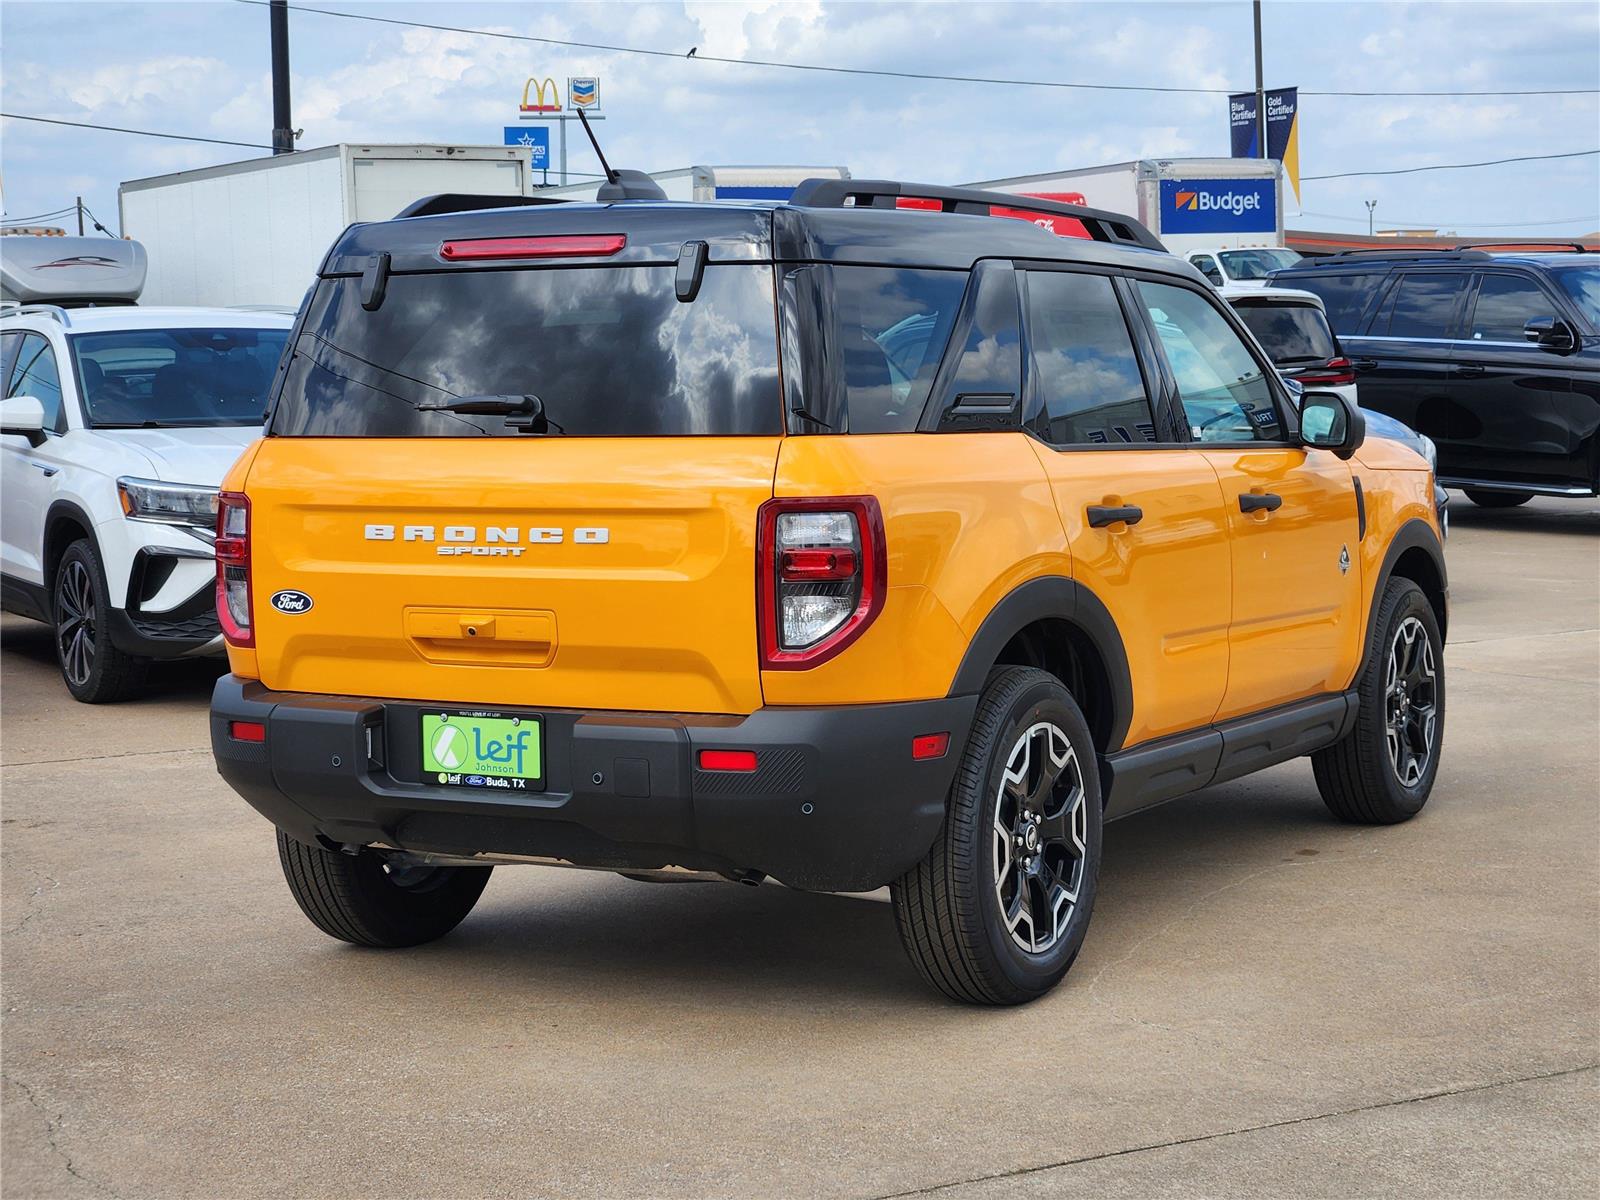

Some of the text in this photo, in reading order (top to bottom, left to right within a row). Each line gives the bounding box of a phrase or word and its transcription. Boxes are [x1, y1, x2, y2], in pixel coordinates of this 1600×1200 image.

[1268, 97, 1282, 106] Gold
[1231, 103, 1245, 112] Blue
[1268, 104, 1294, 116] Certified
[1231, 109, 1256, 121] Certified
[1199, 191, 1260, 216] Budget
[364, 524, 609, 544] BRONCO
[436, 546, 526, 557] SPORT
[277, 593, 305, 610] Ford
[475, 763, 514, 773] Johnson
[486, 778, 510, 788] Buda,
[512, 779, 525, 788] TX
